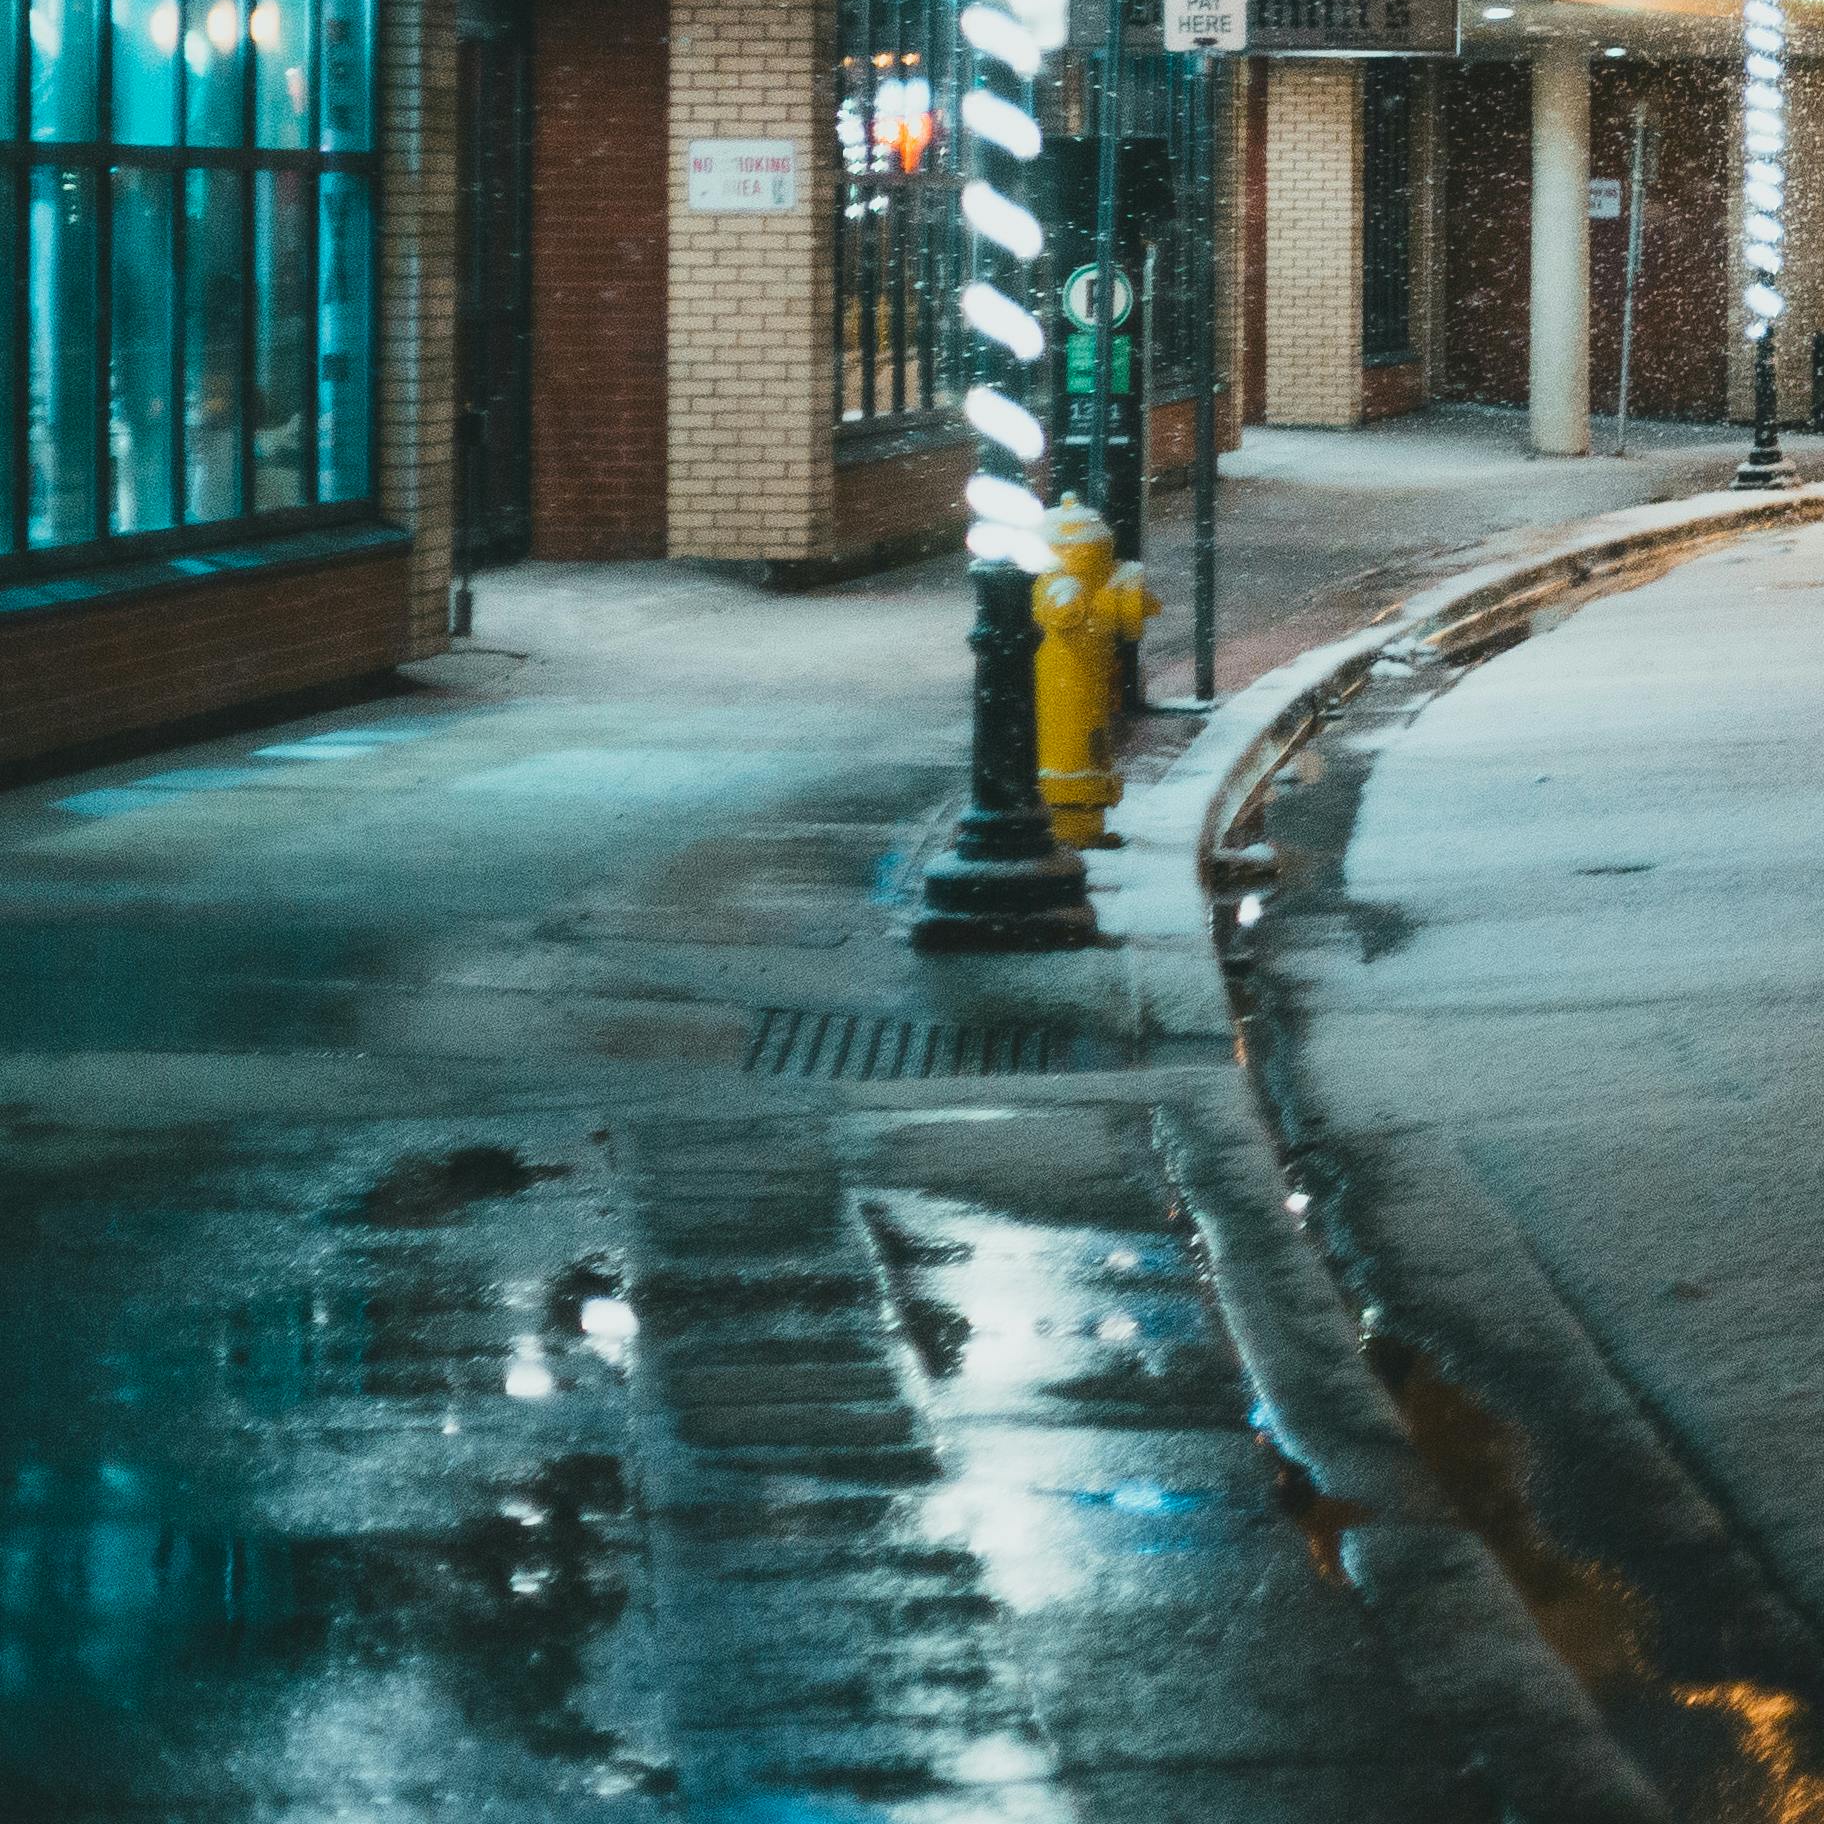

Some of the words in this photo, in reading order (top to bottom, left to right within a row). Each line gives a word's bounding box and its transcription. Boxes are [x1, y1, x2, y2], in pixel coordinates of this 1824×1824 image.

[1178, 14, 1232, 33] HERE
[692, 156, 714, 174] NO
[716, 156, 792, 174] OKING
